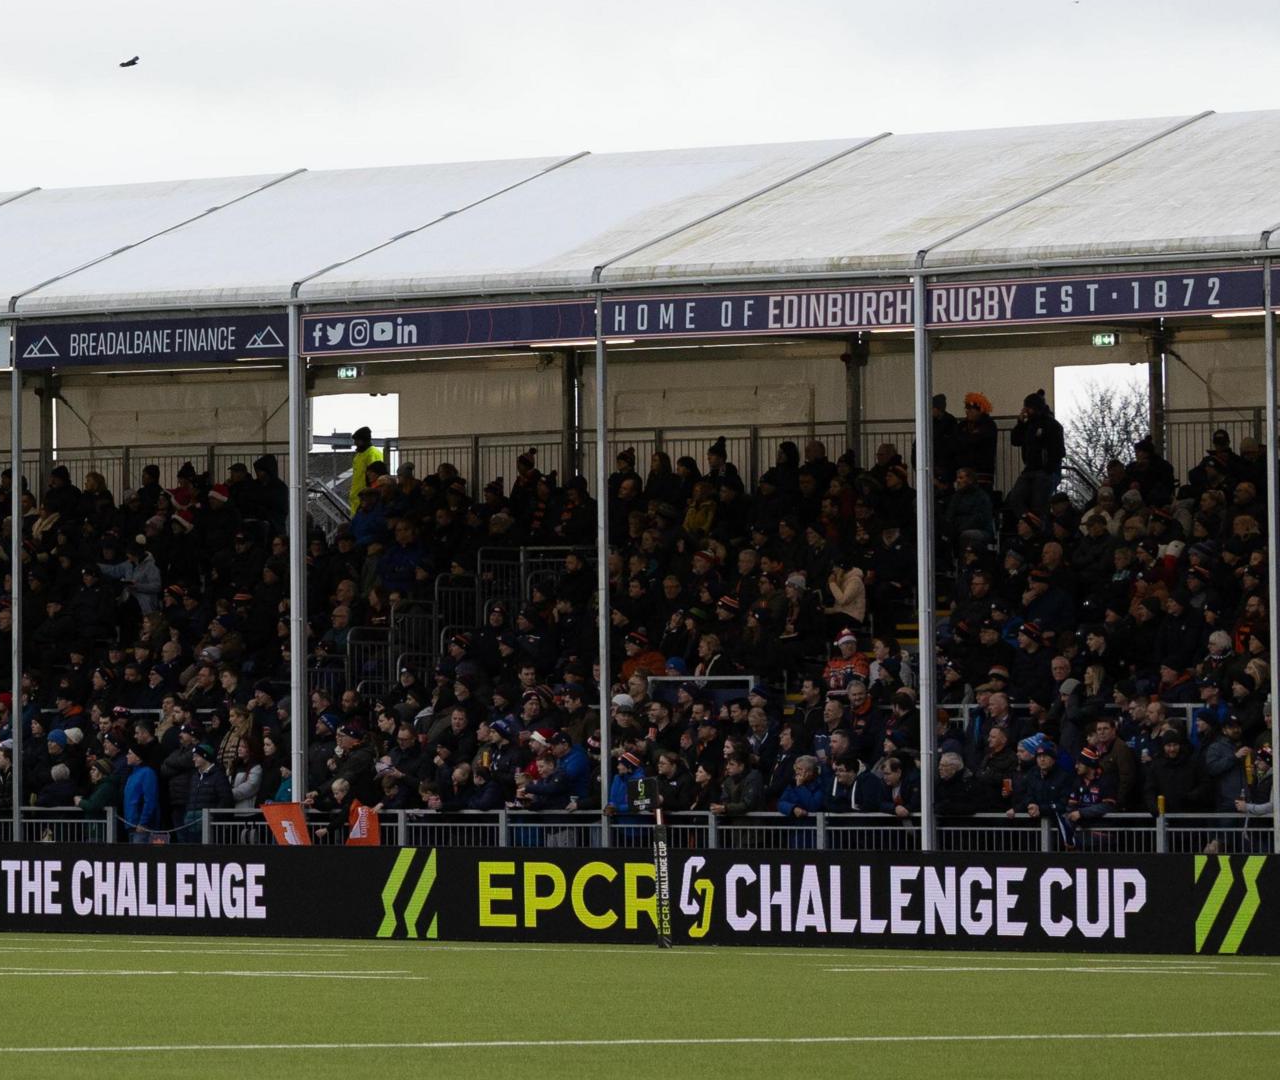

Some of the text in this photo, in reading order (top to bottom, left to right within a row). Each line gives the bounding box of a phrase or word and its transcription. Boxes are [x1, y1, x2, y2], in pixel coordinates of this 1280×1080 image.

[615, 302, 695, 332] HOME
[721, 300, 754, 327] OF
[768, 289, 912, 329] EDINBURGH
[933, 285, 1017, 323] RUGBY
[70, 326, 236, 358] BREADALBANE FINANCE
[1, 860, 61, 915] THE
[72, 860, 267, 919] CHALLENGE
[479, 861, 658, 929] EPCR
[726, 864, 1028, 937] CHALLENGE
[1040, 868, 1147, 938] CUP
[659, 841, 671, 935] EPCR CHALLENGE CUP
